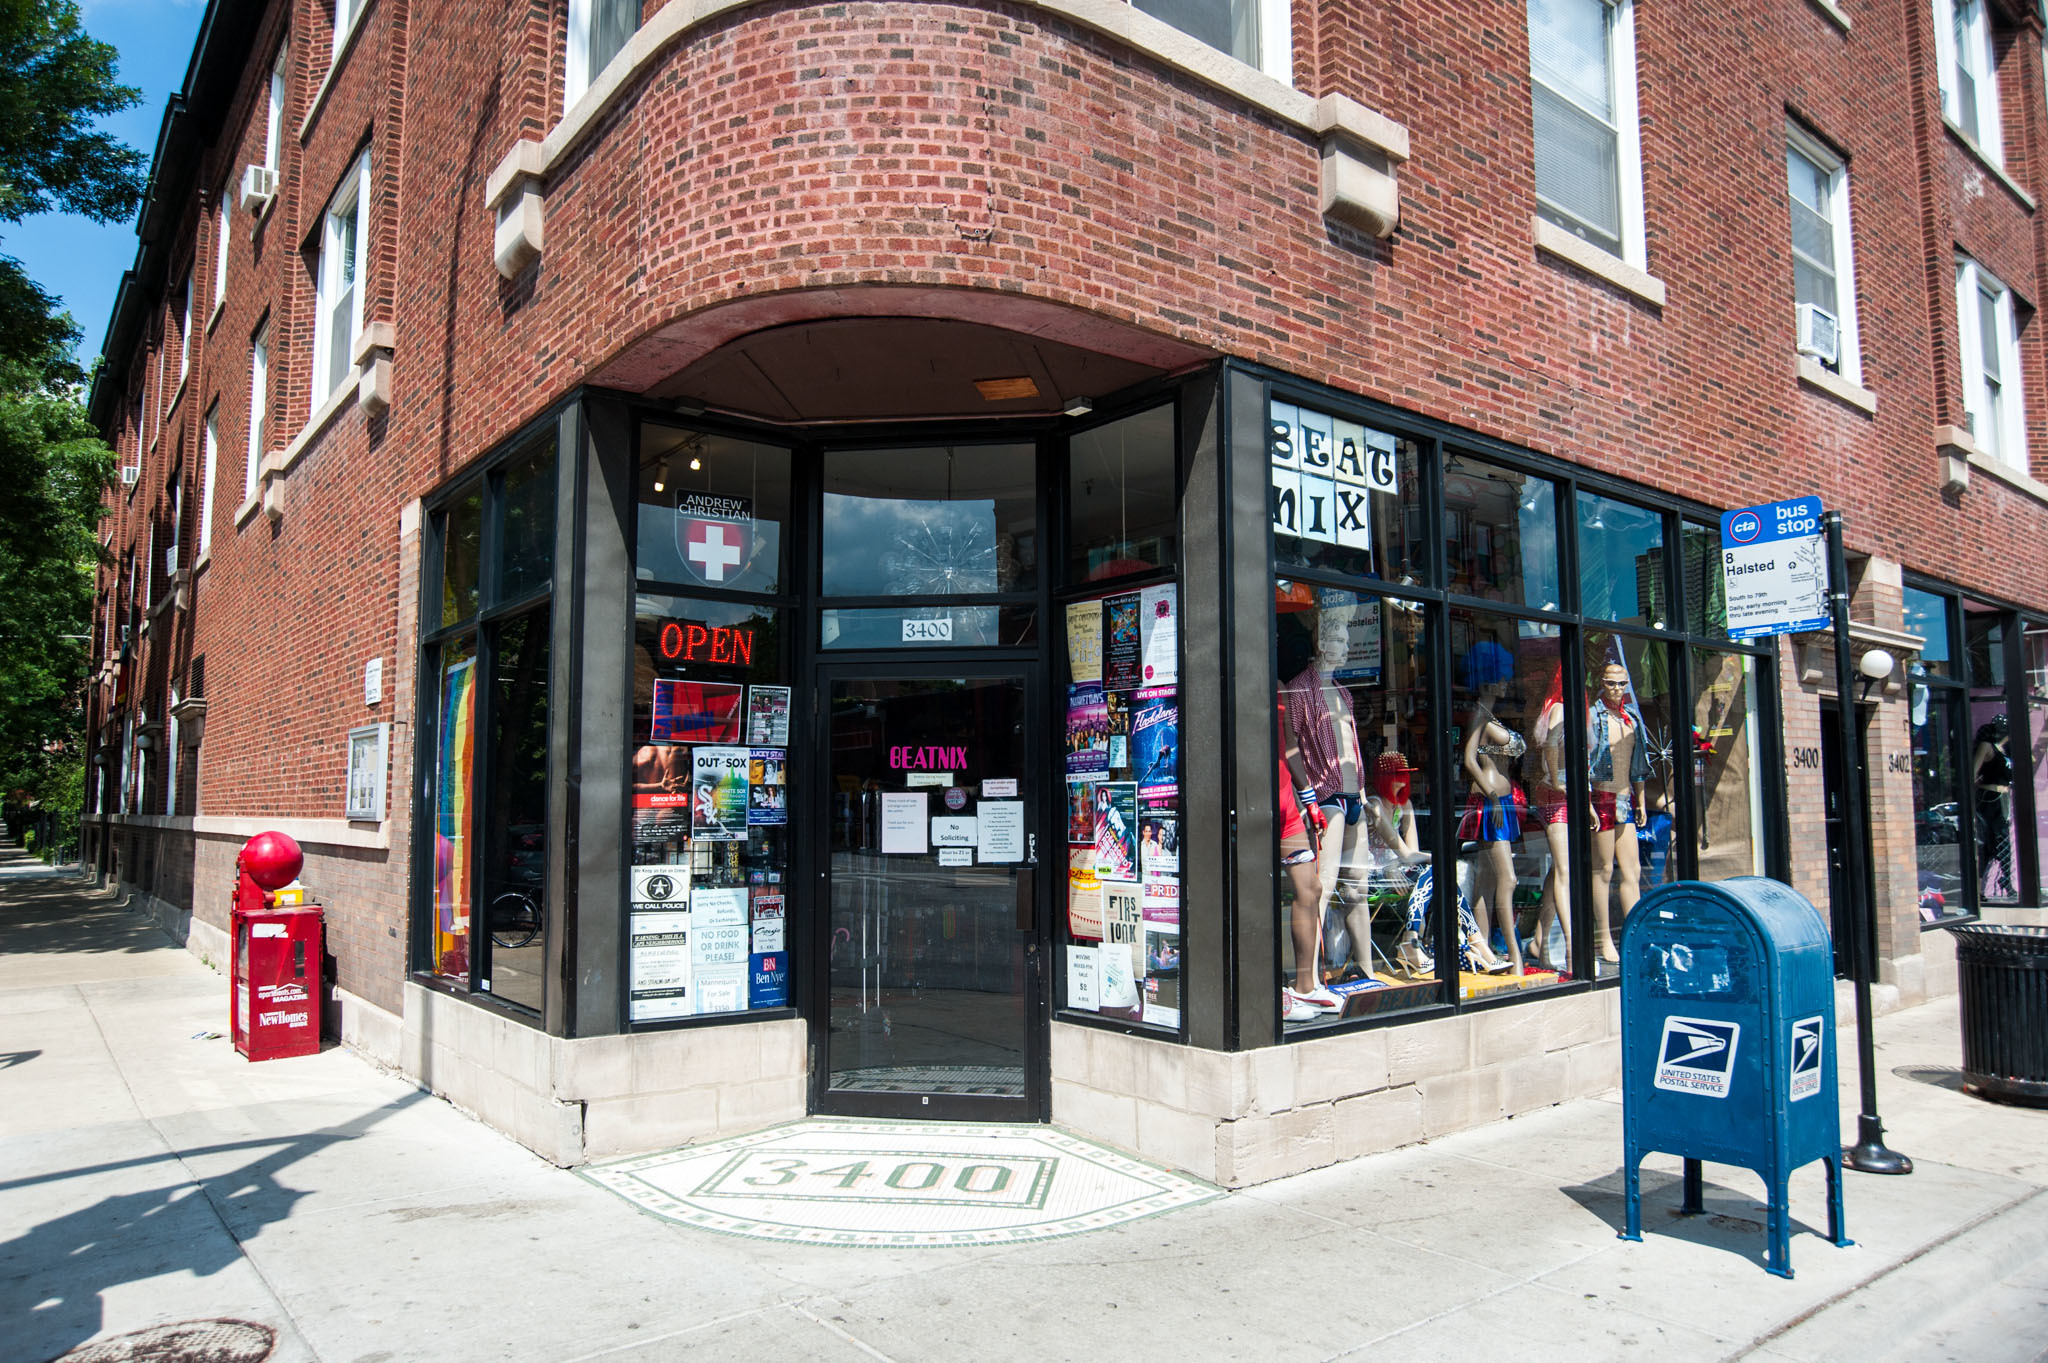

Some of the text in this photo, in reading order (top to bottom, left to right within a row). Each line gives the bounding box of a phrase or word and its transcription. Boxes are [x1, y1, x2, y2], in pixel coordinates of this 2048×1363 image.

[1271, 420, 1394, 486] BEAT
[686, 494, 743, 510] ANDREW
[679, 503, 750, 521] CHRISTIAN
[1776, 504, 1808, 520] bus
[1734, 521, 1756, 533] cta
[1777, 518, 1815, 534] stop
[1725, 552, 1734, 564] 8
[1726, 560, 1775, 576] Halsted
[905, 622, 949, 639] 3400
[660, 623, 755, 665] OPEN
[1137, 691, 1148, 699] LIVE
[1148, 690, 1158, 698] ON
[697, 757, 747, 768] OUT SOX
[890, 746, 968, 770] BEATNIX
[1793, 748, 1819, 769] 3400
[1889, 754, 1910, 774] 3402
[1028, 833, 1036, 859] PULL
[1151, 884, 1179, 898] PRID
[1109, 896, 1141, 923] FIRST
[701, 930, 740, 939] NO FOOD
[700, 941, 740, 951] OR DRINK
[705, 952, 735, 961] PLEASE!
[763, 957, 776, 971] BN
[756, 971, 784, 986] Ben Nye
[1079, 983, 1088, 991] $2
[272, 994, 308, 1003] MAGAZINE
[259, 1011, 308, 1027] NewHomes
[1661, 1068, 1721, 1083] UNITED STATES
[1660, 1076, 1724, 1093] POSTAL SERVICE
[742, 1158, 1018, 1194] 3400
